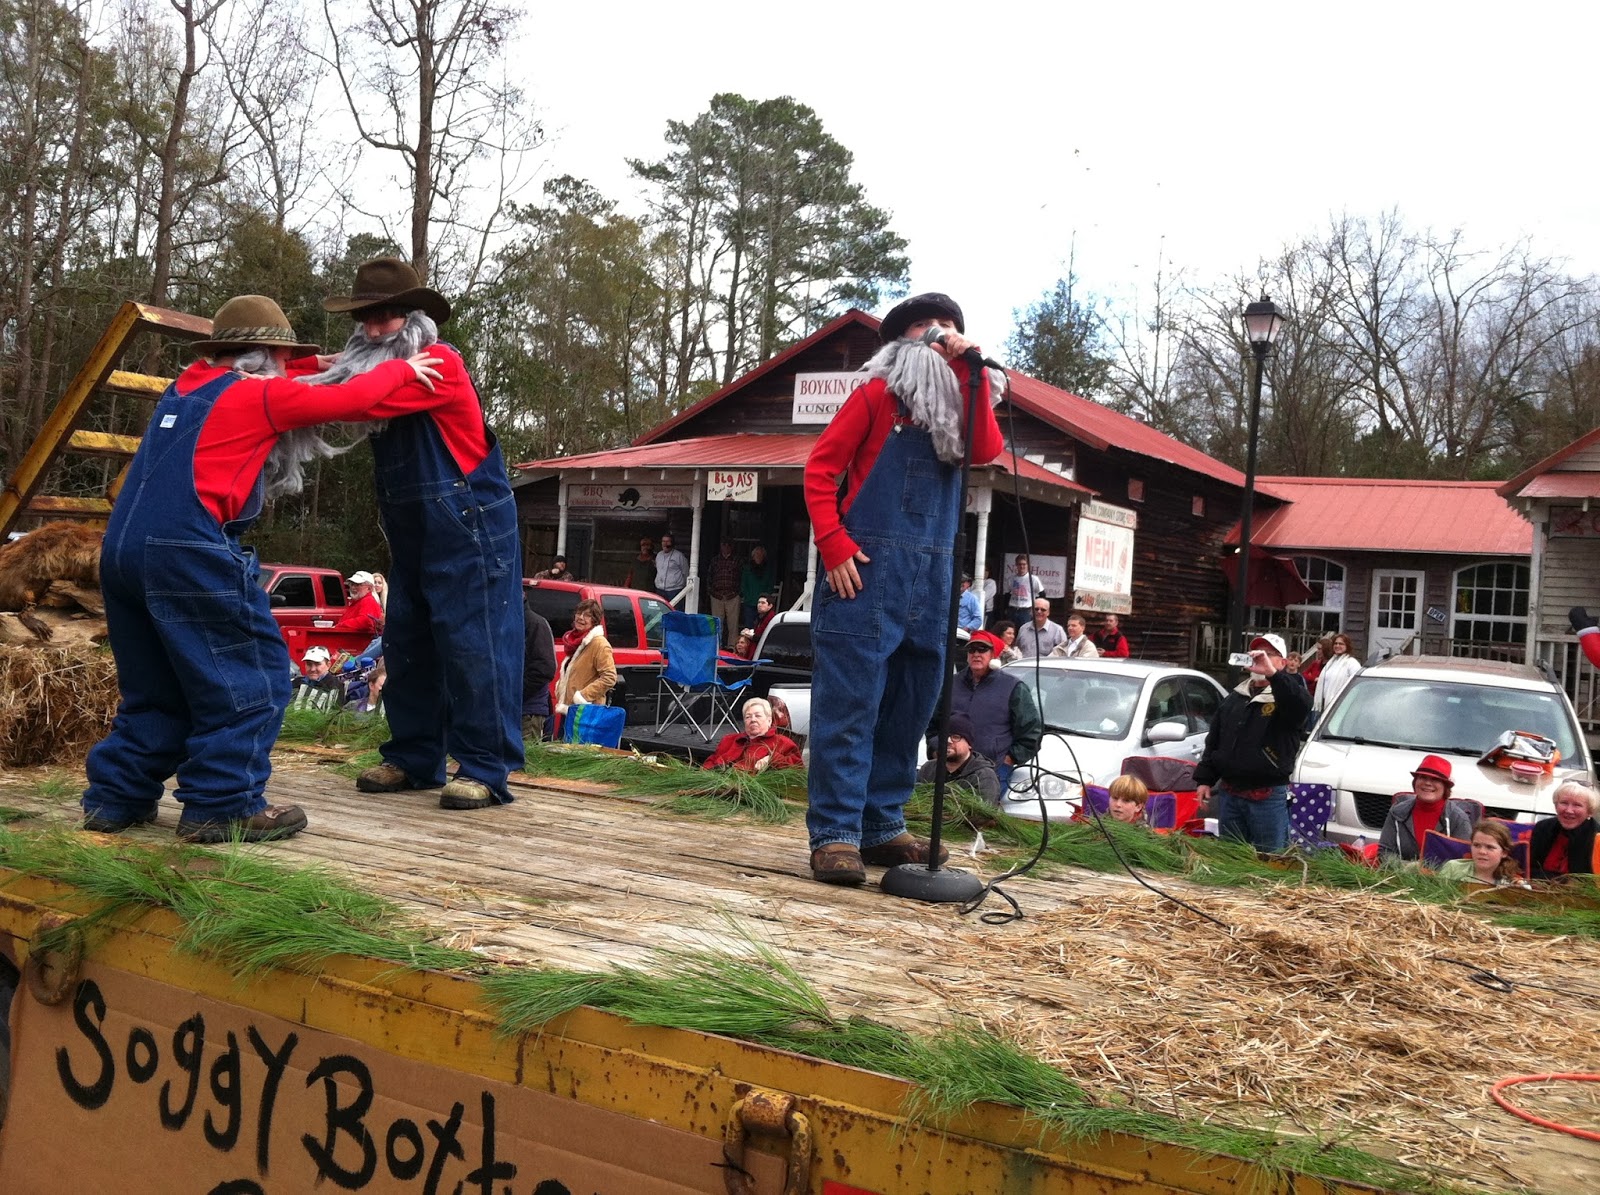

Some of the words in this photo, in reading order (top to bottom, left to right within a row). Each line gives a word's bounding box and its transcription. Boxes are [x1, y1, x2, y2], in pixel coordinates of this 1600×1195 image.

[800, 378, 847, 396] BOYKIN
[583, 486, 604, 498] BBQ
[1084, 535, 1115, 569] NEHI
[1030, 565, 1060, 577] Hours
[1083, 570, 1113, 586] beverages
[1428, 608, 1446, 621] OPEN
